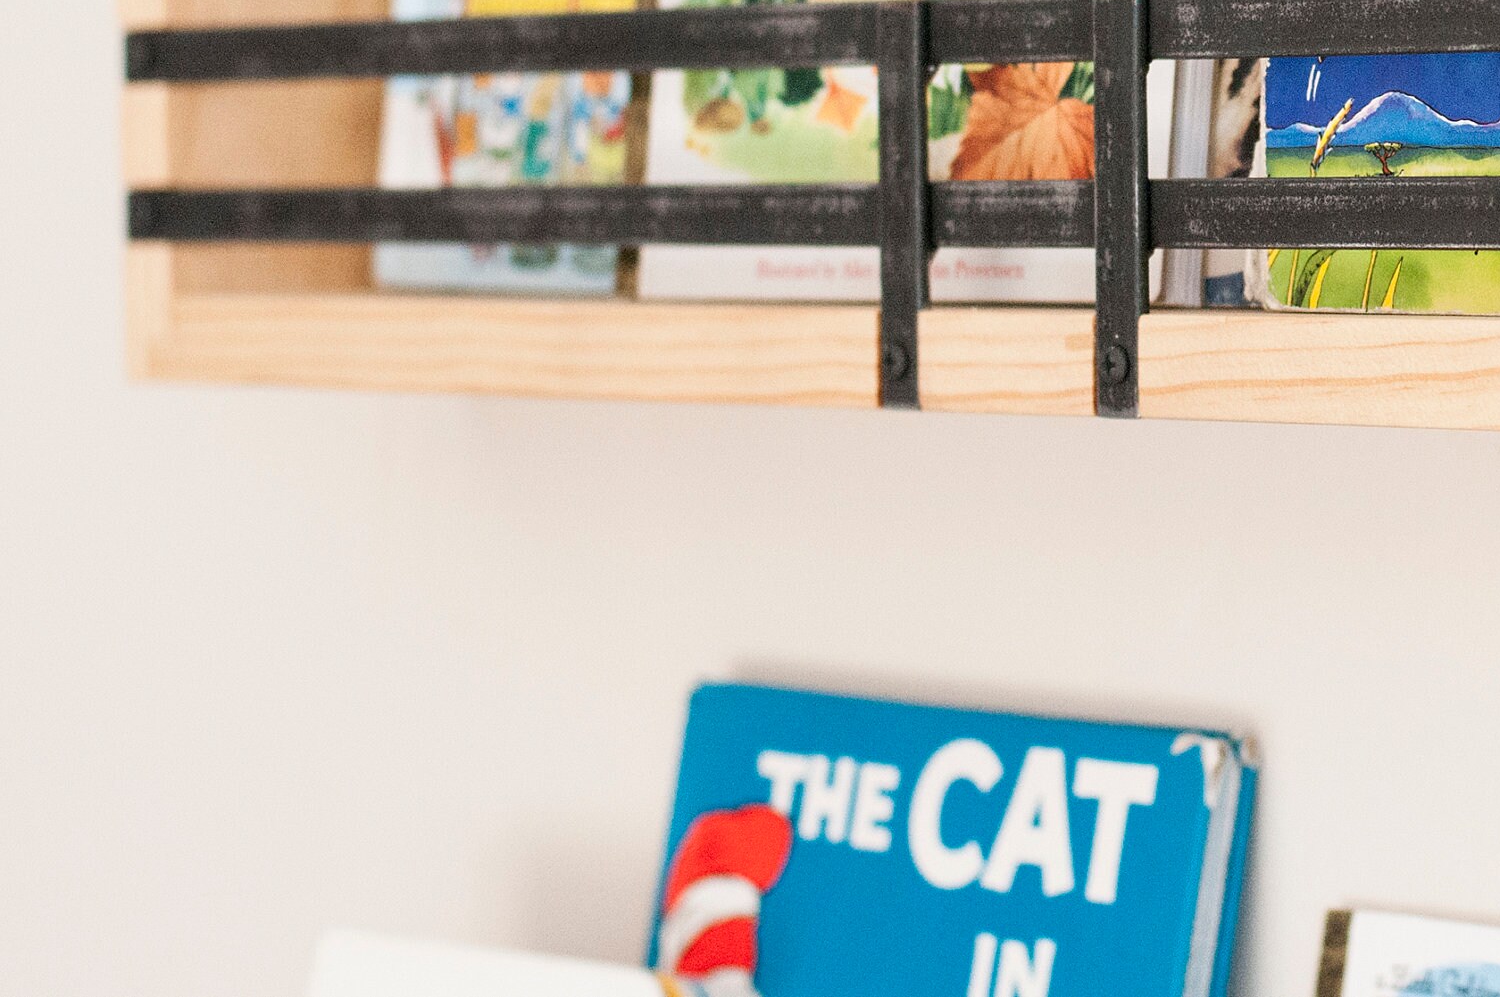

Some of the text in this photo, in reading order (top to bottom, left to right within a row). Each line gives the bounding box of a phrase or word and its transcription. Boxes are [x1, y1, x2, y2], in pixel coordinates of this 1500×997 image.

[756, 737, 1160, 906] THE CAT
[965, 930, 1058, 997] IN
